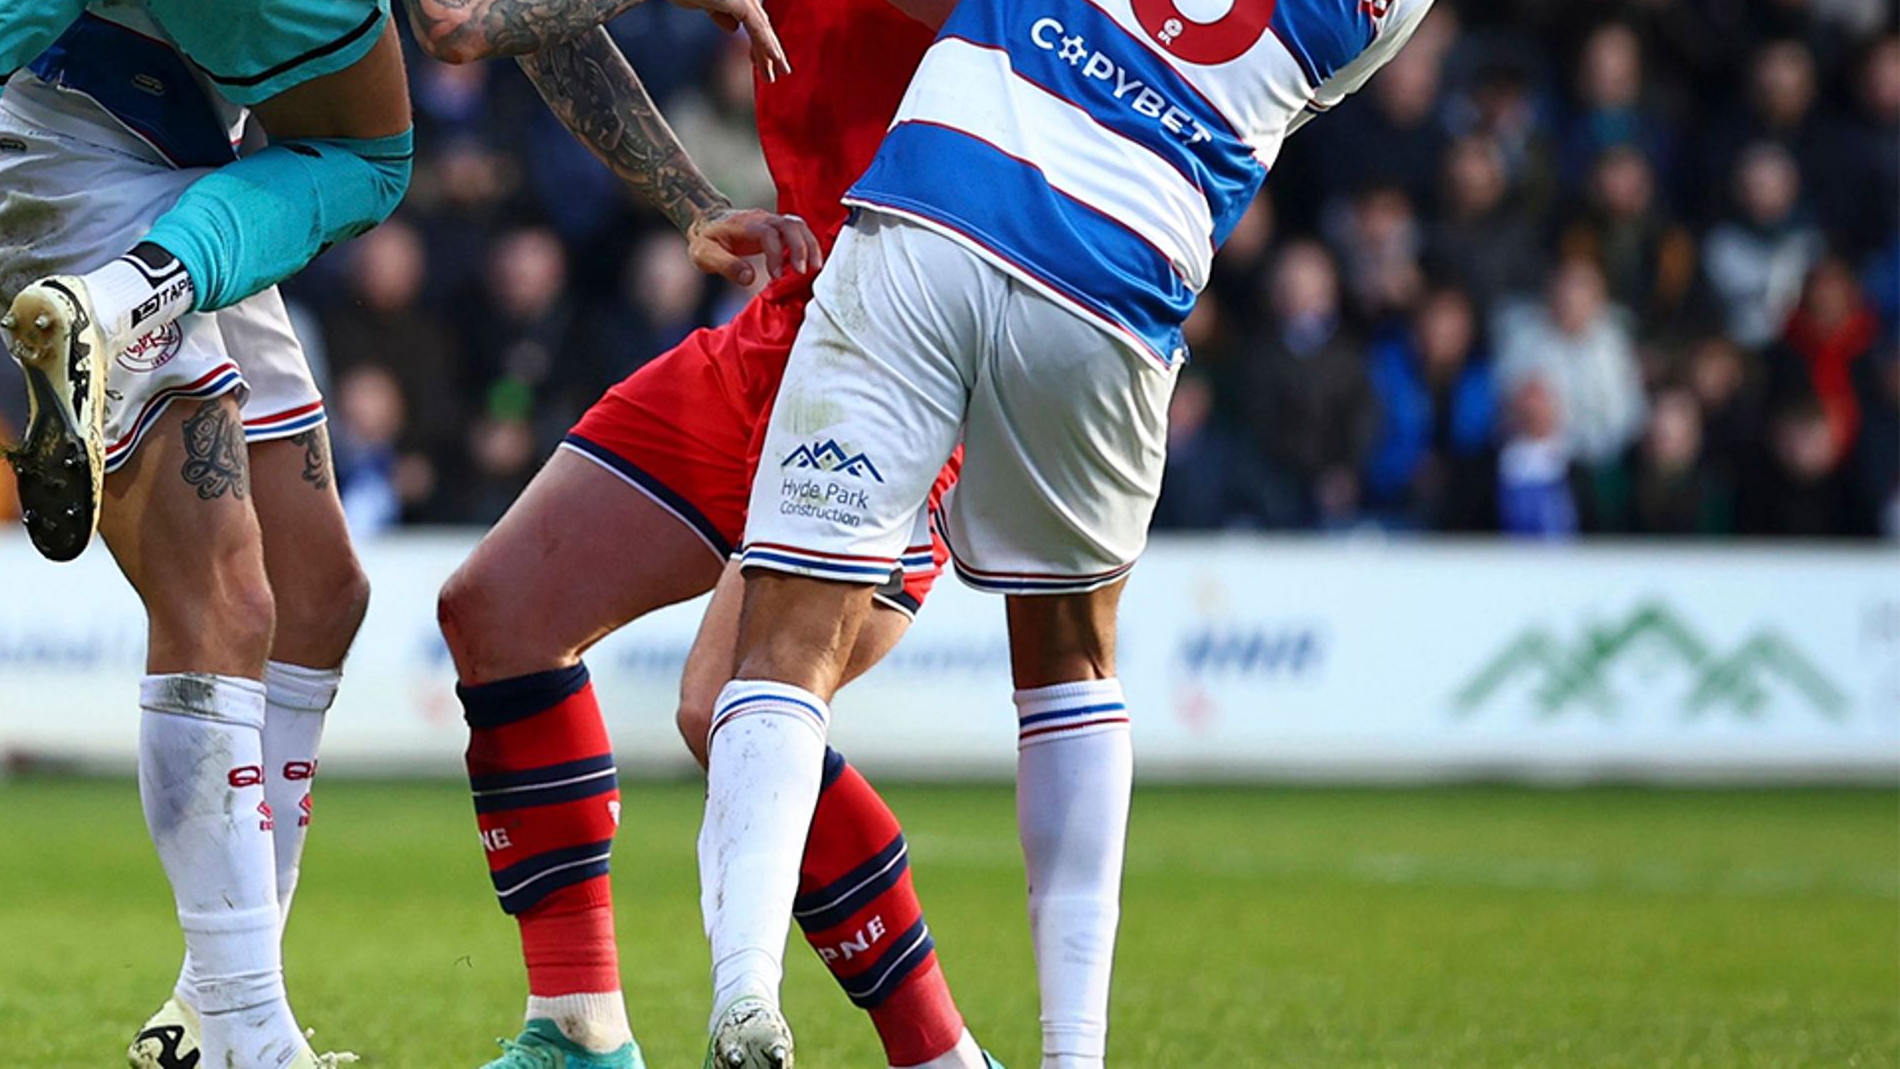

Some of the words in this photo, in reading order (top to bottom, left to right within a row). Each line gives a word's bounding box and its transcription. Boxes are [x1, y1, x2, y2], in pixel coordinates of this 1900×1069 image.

[1029, 18, 1214, 146] COPYBET
[780, 479, 821, 499] Hyde
[825, 482, 870, 510] Park
[780, 500, 861, 528] Construction
[819, 914, 886, 965] PNE
